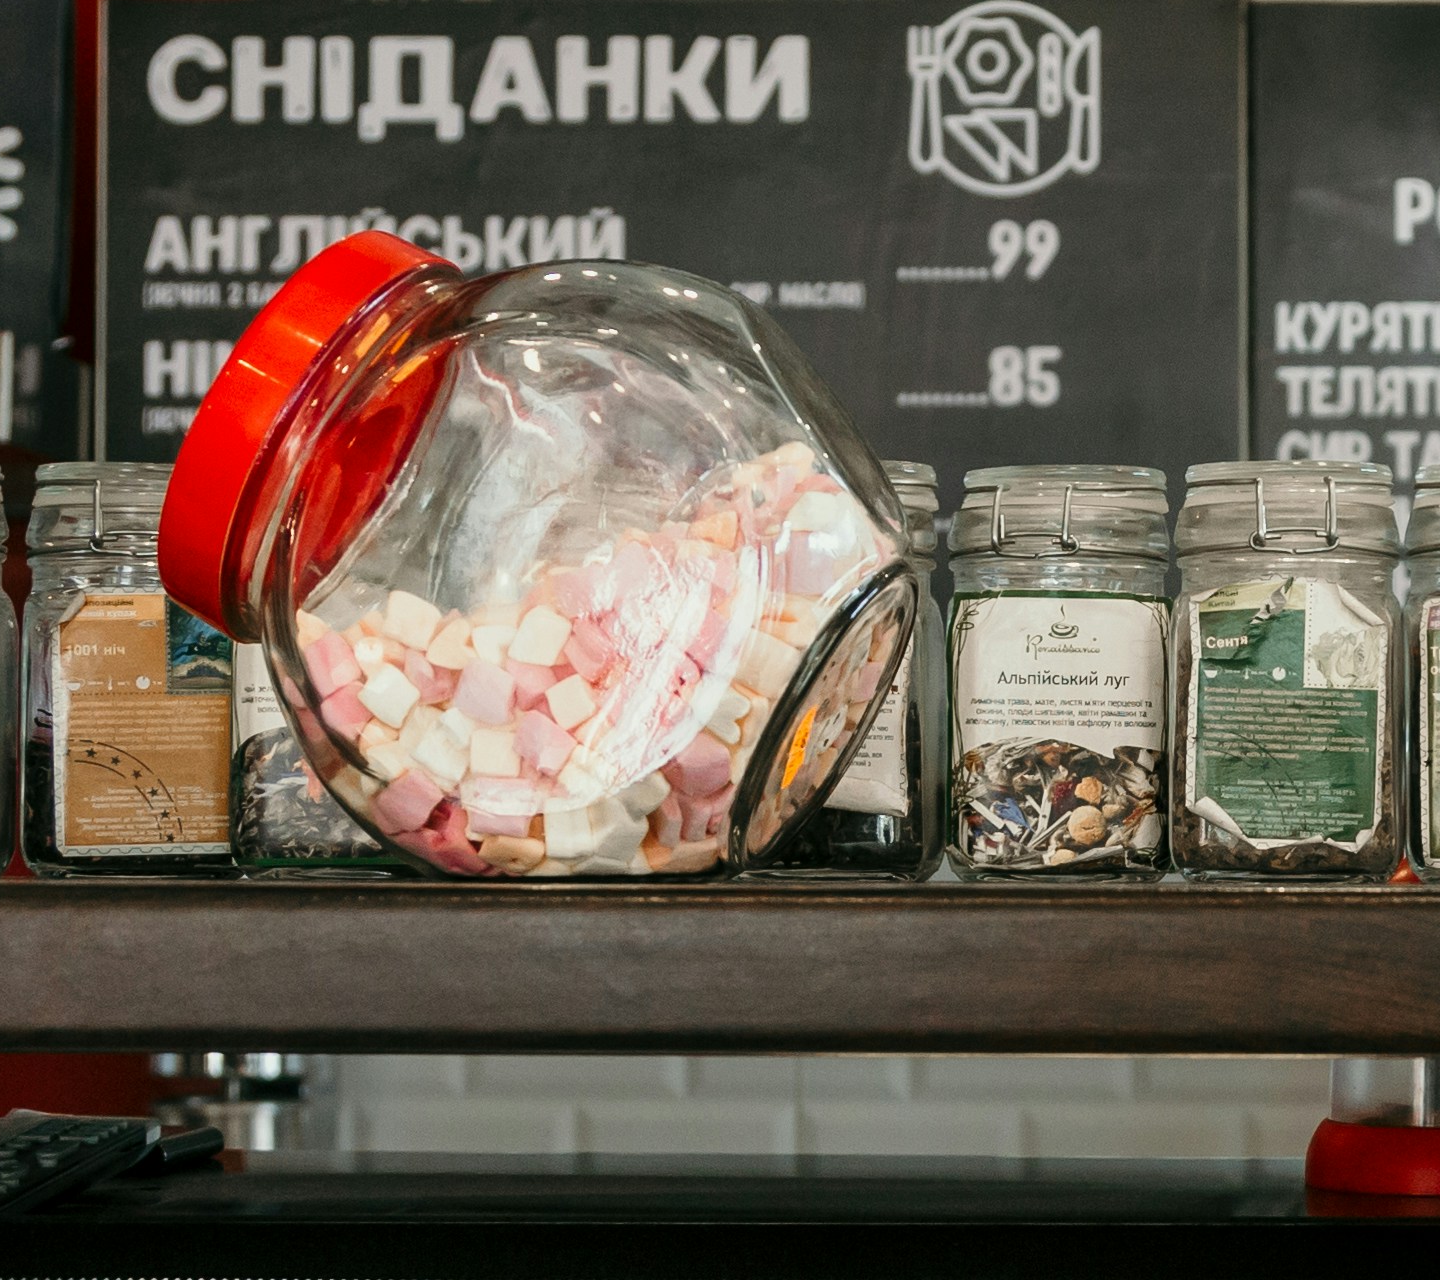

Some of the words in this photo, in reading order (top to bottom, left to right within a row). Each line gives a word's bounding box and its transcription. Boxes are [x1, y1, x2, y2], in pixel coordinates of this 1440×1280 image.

[147, 33, 811, 143] СНІДАНКИ
[989, 219, 1060, 282] 99
[989, 344, 1061, 408] 85
[997, 670, 1099, 686] Альпійський
[1104, 676, 1130, 689] луг
